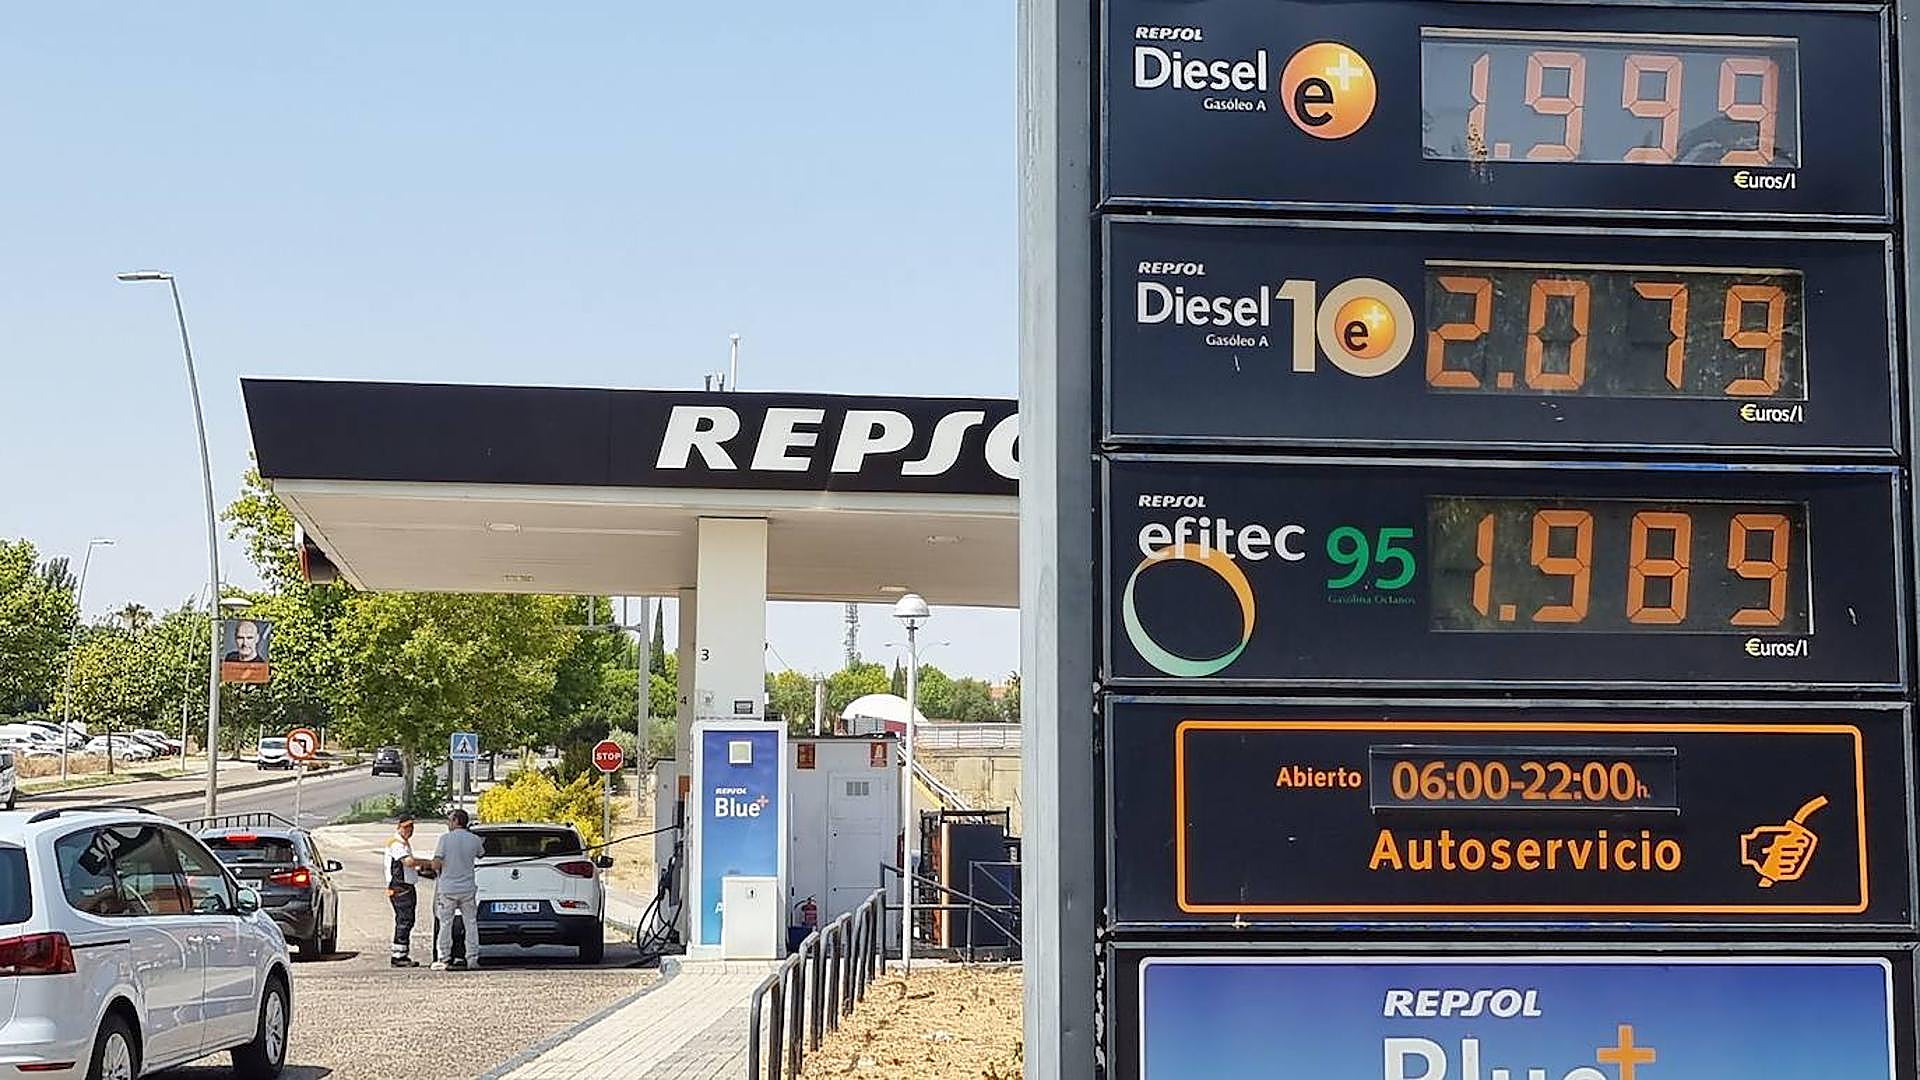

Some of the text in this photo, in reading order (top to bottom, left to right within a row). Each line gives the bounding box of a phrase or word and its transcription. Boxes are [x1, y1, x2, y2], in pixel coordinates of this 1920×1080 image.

[1134, 26, 1203, 41] REPSOL
[1134, 45, 1268, 92] Diesel
[1203, 97, 1267, 112] Gasóleo A
[1467, 50, 1780, 166] 1.999
[1733, 171, 1797, 190] €uros/l
[1137, 261, 1206, 276] REPSOL
[1136, 281, 1270, 327] Diesel
[1205, 333, 1270, 348] Gasóleo A
[1425, 275, 1787, 396] 2.079
[1740, 403, 1804, 424] €uros/l
[1138, 494, 1206, 509] REPSOL
[1138, 516, 1417, 590] efitec 95
[1472, 508, 1791, 626] 1.989
[701, 649, 710, 661] 3
[1744, 637, 1809, 657] €uros/l
[596, 752, 621, 761] STOP
[1275, 766, 1363, 788] Abierto
[1368, 829, 1683, 871] Autoservicio
[1383, 989, 1542, 1018] REPSOL
